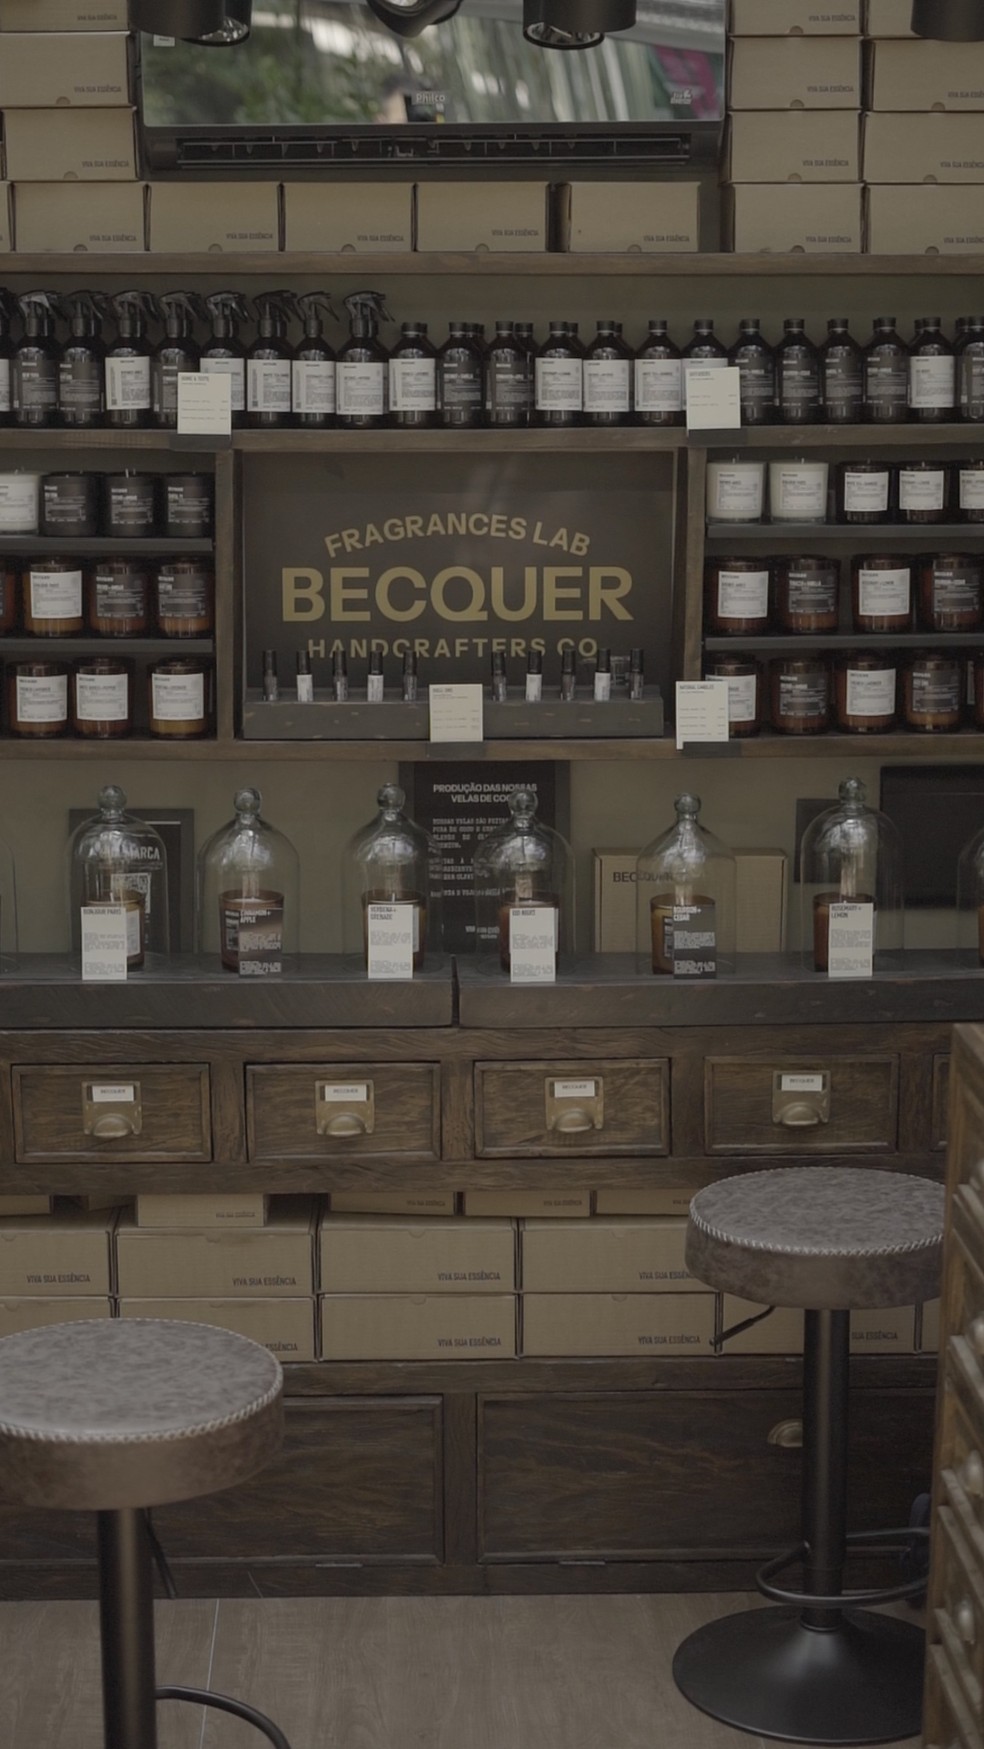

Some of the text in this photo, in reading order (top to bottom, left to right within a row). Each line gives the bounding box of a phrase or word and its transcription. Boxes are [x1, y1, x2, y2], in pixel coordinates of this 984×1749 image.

[416, 92, 446, 104] Philco
[324, 512, 592, 558] FRAGRANCES LAB
[281, 565, 634, 623] BECQUER
[307, 638, 545, 659] HANDCRAFTERS
[433, 783, 482, 794] PRODUÇÃO
[482, 784, 501, 792] DAS
[451, 794, 480, 803] VELAS
[480, 794, 492, 803] DE
[27, 1273, 90, 1283] VIVA SUA ESSÊNCIA
[233, 1275, 296, 1286] VIVA SUA ESSÊNCIA
[438, 1270, 500, 1280] VIVA SUA ESSÊNCIA
[639, 1271, 653, 1279] VIVA
[654, 1271, 668, 1279] SUA
[638, 1334, 700, 1344] VIVA SUA ESSÊNCIA
[852, 1330, 898, 1340] SUA ESSÊNCIA
[438, 1336, 501, 1347] VIVA SUA ESSÊNCIA
